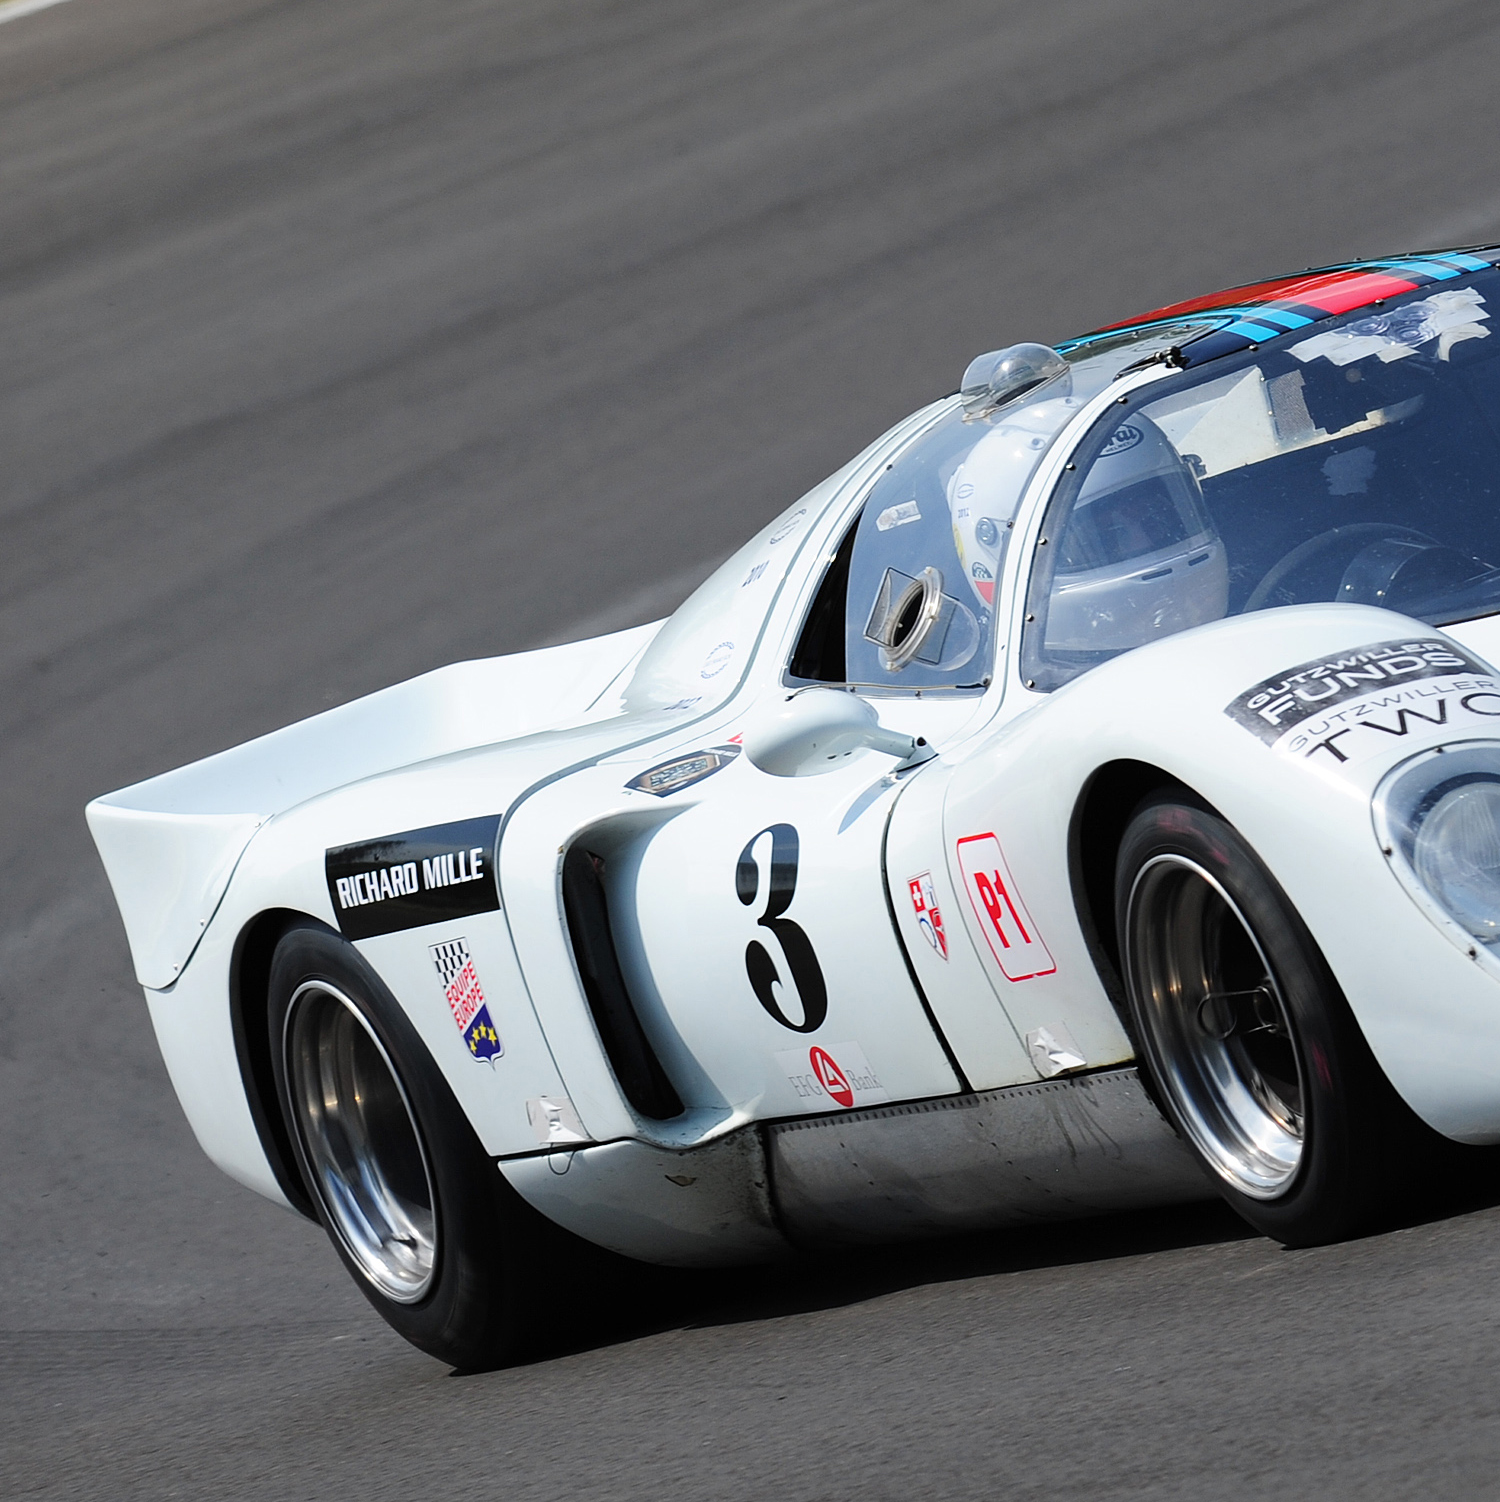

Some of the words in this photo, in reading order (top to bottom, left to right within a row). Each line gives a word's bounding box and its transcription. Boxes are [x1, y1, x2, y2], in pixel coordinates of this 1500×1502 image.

[1247, 642, 1451, 710] GUTZWILLER
[1258, 651, 1467, 726] FUNDS
[1288, 679, 1499, 752] GUTZWILLER
[336, 861, 419, 909] RICHARD
[422, 847, 484, 890] MILLE
[973, 869, 1032, 949] P1
[735, 823, 828, 1034] 3
[446, 960, 477, 1010] EQUIPE
[454, 981, 484, 1031] EUROPE
[788, 1074, 823, 1098] EFG
[845, 1066, 884, 1091] Bank
